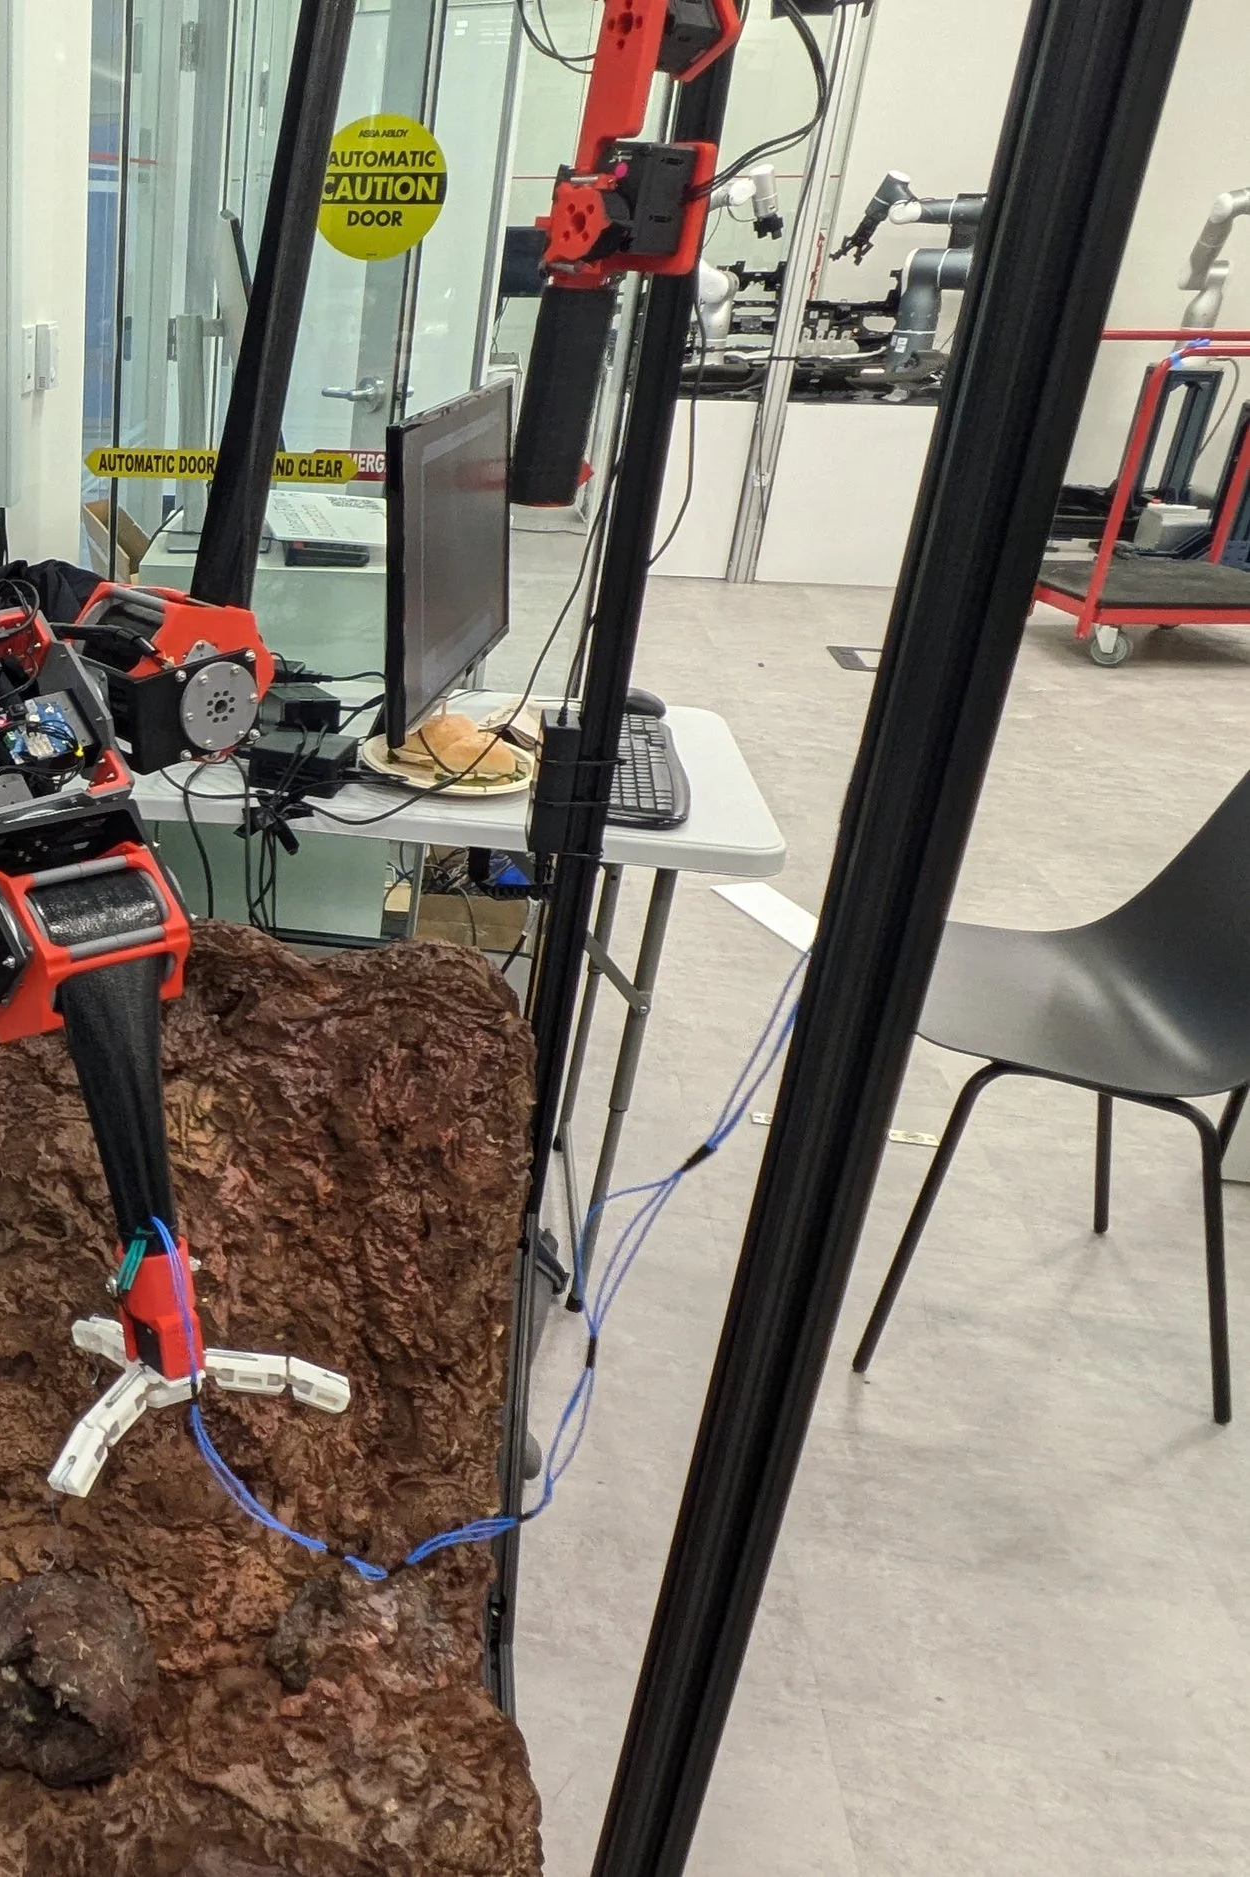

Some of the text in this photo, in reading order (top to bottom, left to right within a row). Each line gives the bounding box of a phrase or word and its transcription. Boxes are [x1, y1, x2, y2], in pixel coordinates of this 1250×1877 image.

[358, 129, 409, 138] ASSA ABLOY
[328, 150, 436, 168] AUTOMATIC
[321, 175, 438, 201] CAUTION
[346, 210, 403, 227] DOOR
[98, 453, 343, 478] AUTOMATIC DOOR ND CLEAR
